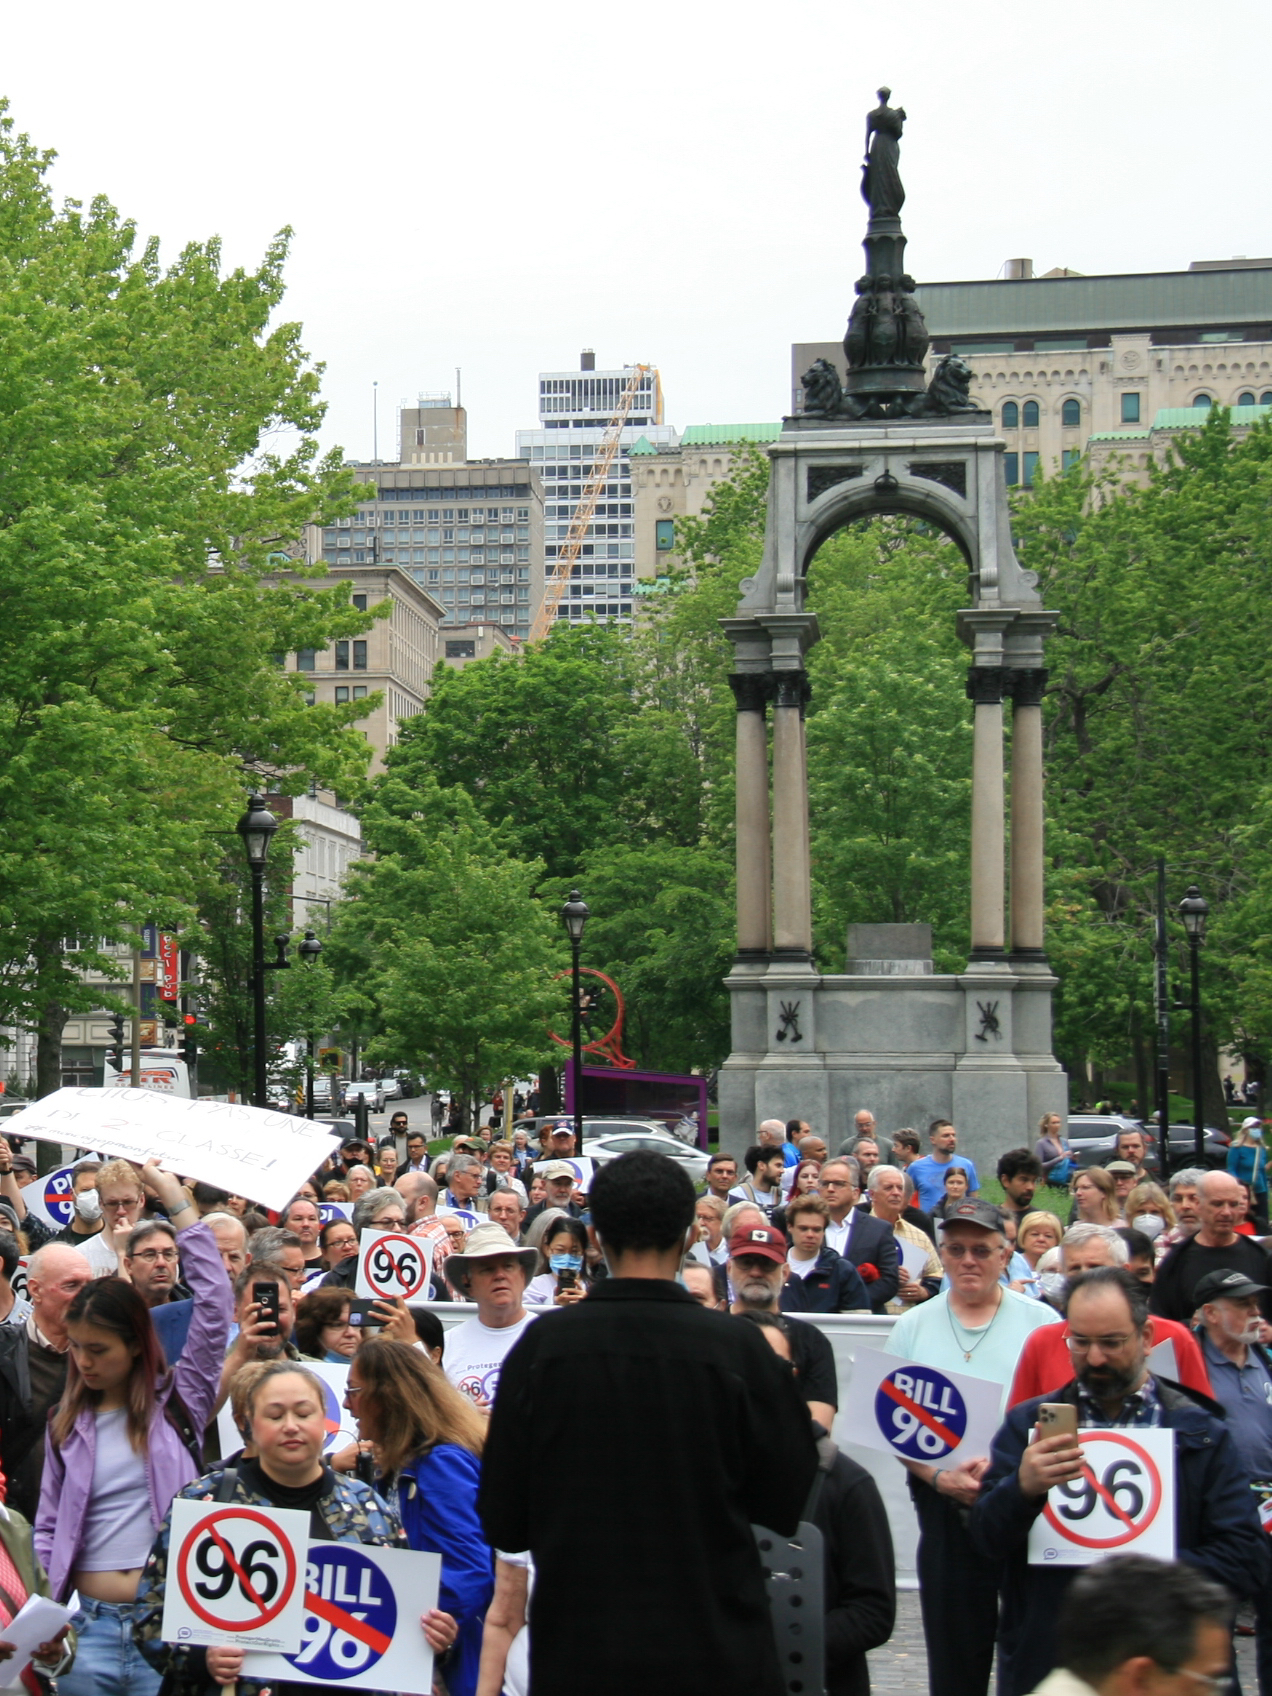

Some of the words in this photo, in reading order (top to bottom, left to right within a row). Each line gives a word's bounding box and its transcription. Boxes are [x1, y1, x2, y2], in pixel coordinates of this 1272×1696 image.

[263, 1113, 321, 1138] UNE
[156, 1130, 278, 1171] CLASSE!
[373, 1250, 417, 1287] 96
[893, 1372, 958, 1415] BILL
[891, 1405, 946, 1454] 96
[1055, 1459, 1144, 1521] 96
[194, 1535, 280, 1604] 96
[294, 1611, 370, 1669] 96
